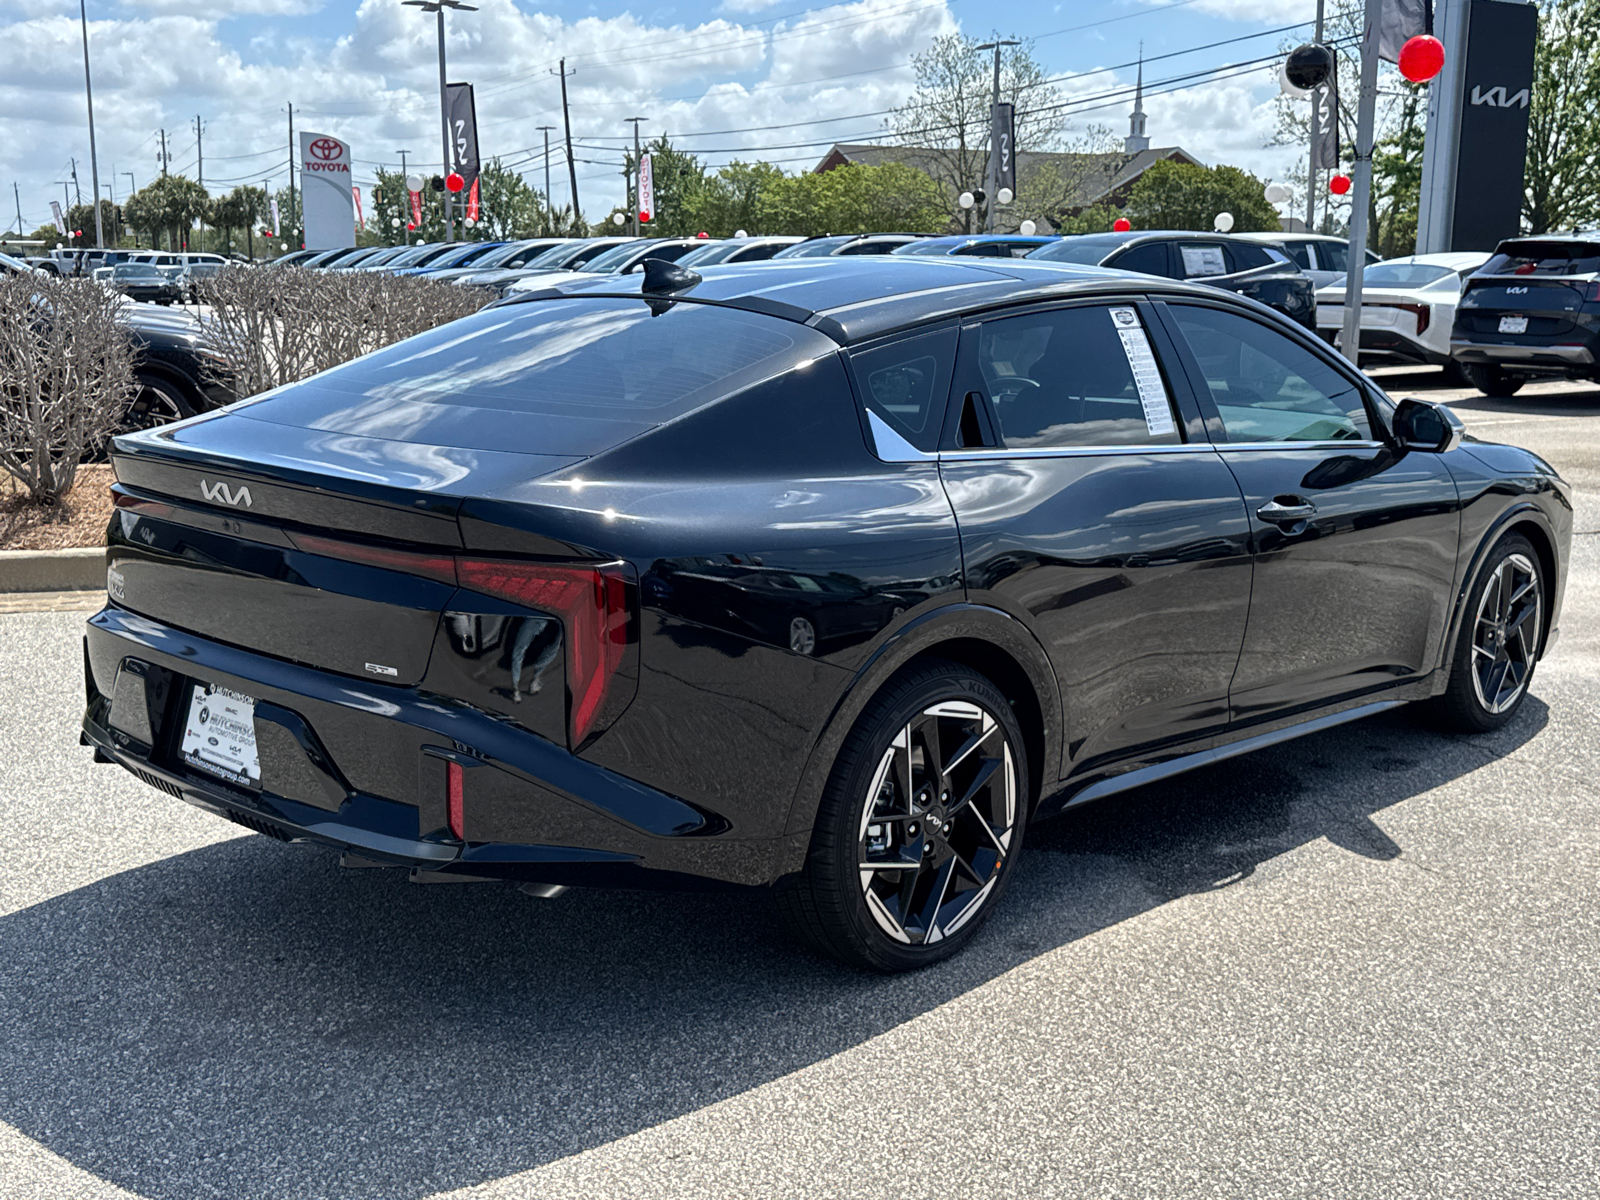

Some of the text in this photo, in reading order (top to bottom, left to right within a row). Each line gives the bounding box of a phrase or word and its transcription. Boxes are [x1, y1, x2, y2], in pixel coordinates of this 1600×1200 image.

[1471, 85, 1529, 109] KIA
[305, 162, 350, 172] TOYOTA
[200, 479, 253, 507] KIA
[216, 686, 254, 706] HUTCHINSON
[968, 681, 1007, 717] KUMHO
[208, 726, 238, 742] AUTOMOTIVE
